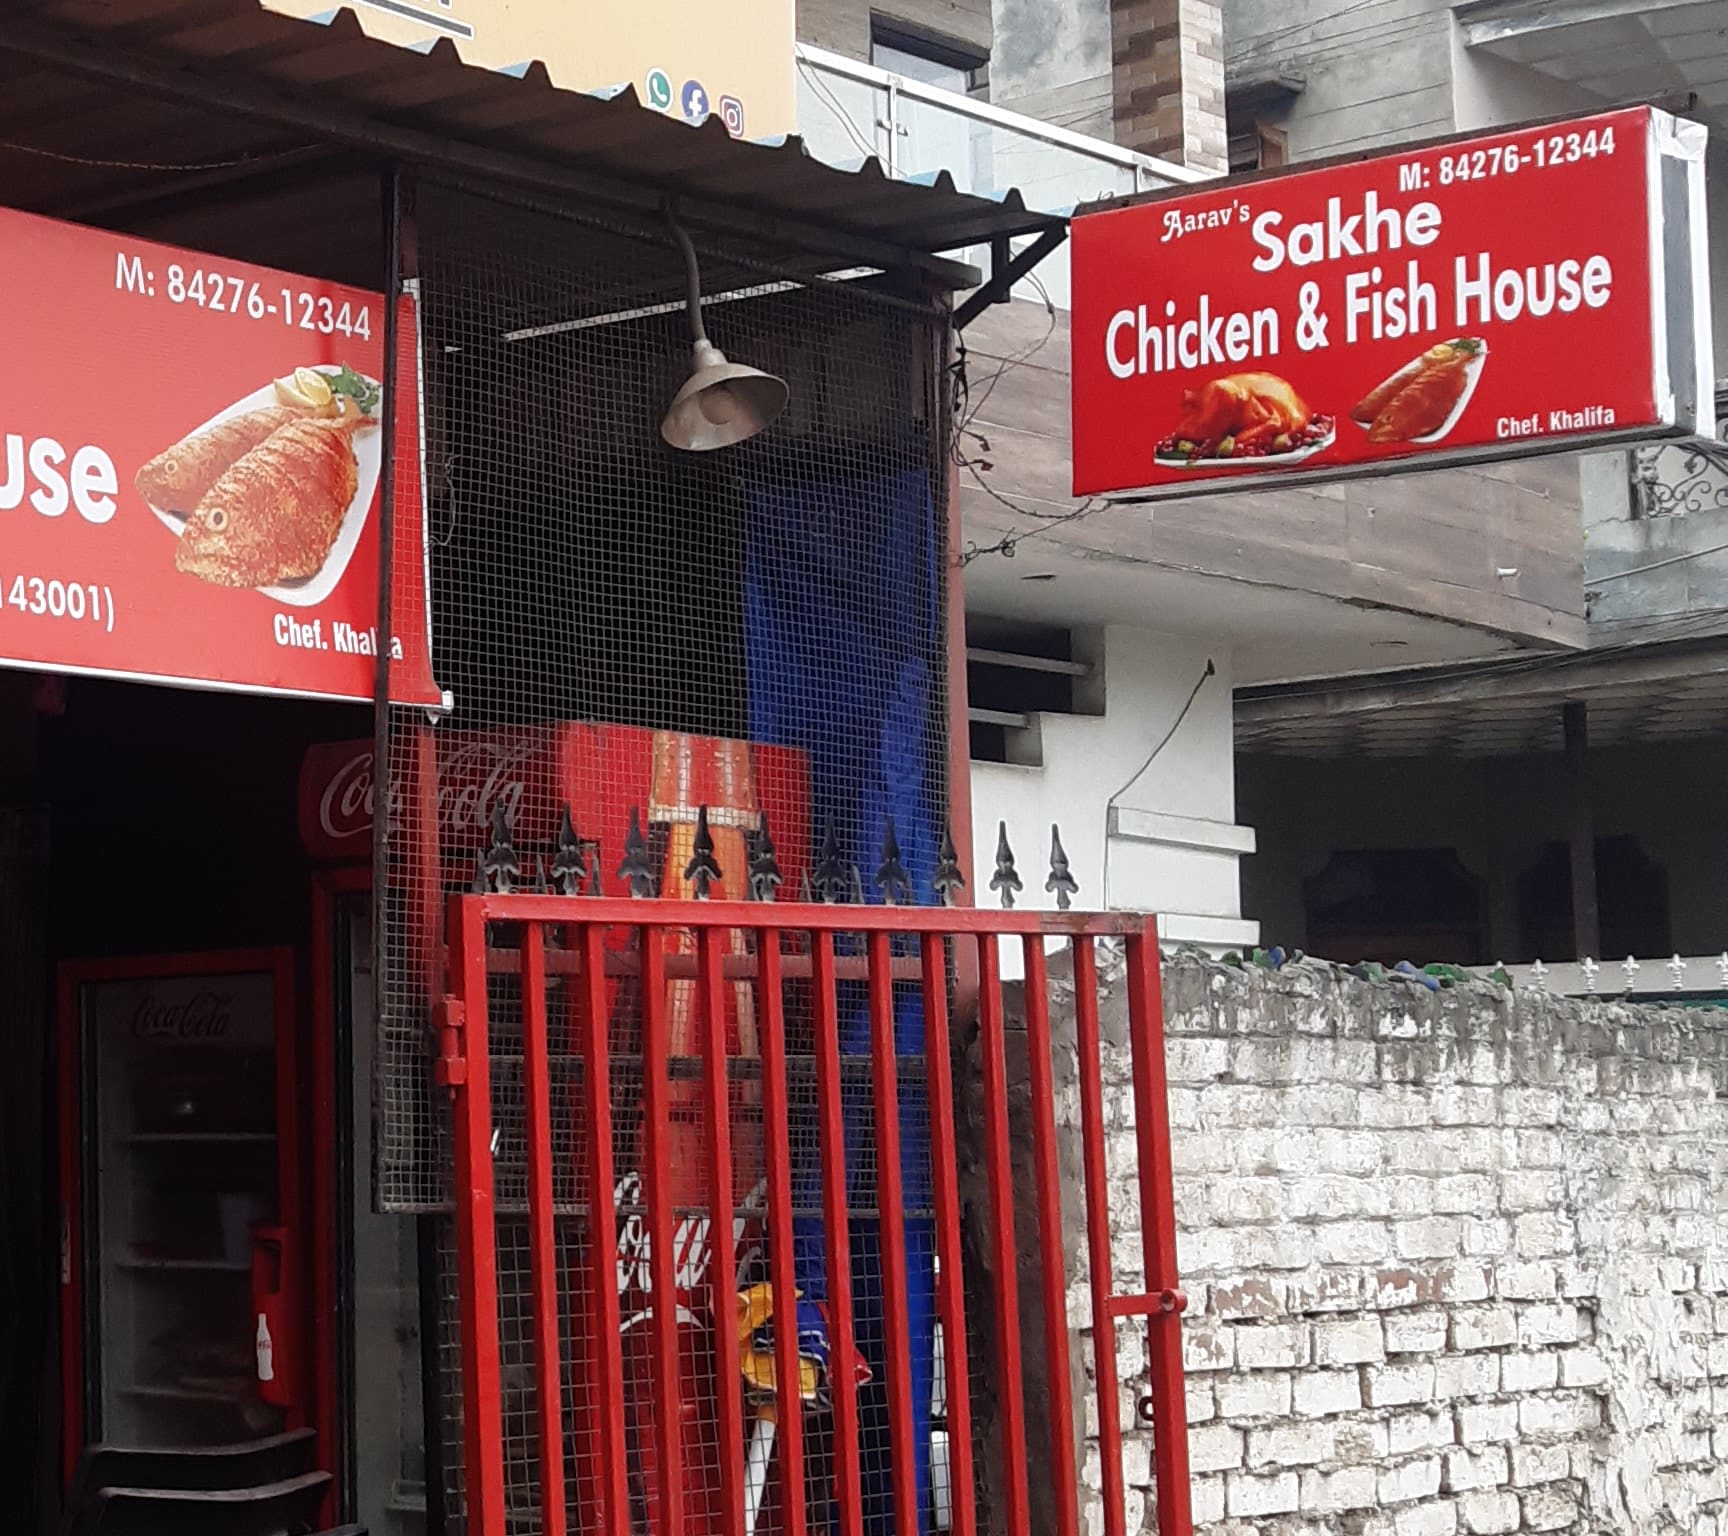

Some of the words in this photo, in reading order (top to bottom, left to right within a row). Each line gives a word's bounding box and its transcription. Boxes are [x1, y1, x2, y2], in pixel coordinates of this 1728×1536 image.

[1399, 163, 1432, 191] M:
[1439, 127, 1615, 186] 84276-12344
[1251, 190, 1441, 272] Sakhe
[116, 252, 155, 295] M:
[168, 265, 371, 341] 84276-12344
[1105, 294, 1279, 378] Chicken
[1297, 281, 1327, 350] &
[1346, 259, 1436, 343] Fish
[1455, 253, 1612, 327] House
[1497, 414, 1543, 439] Chef.
[1550, 405, 1615, 432] Khalifa
[274, 614, 328, 650] Chef.
[333, 617, 404, 660] Khala
